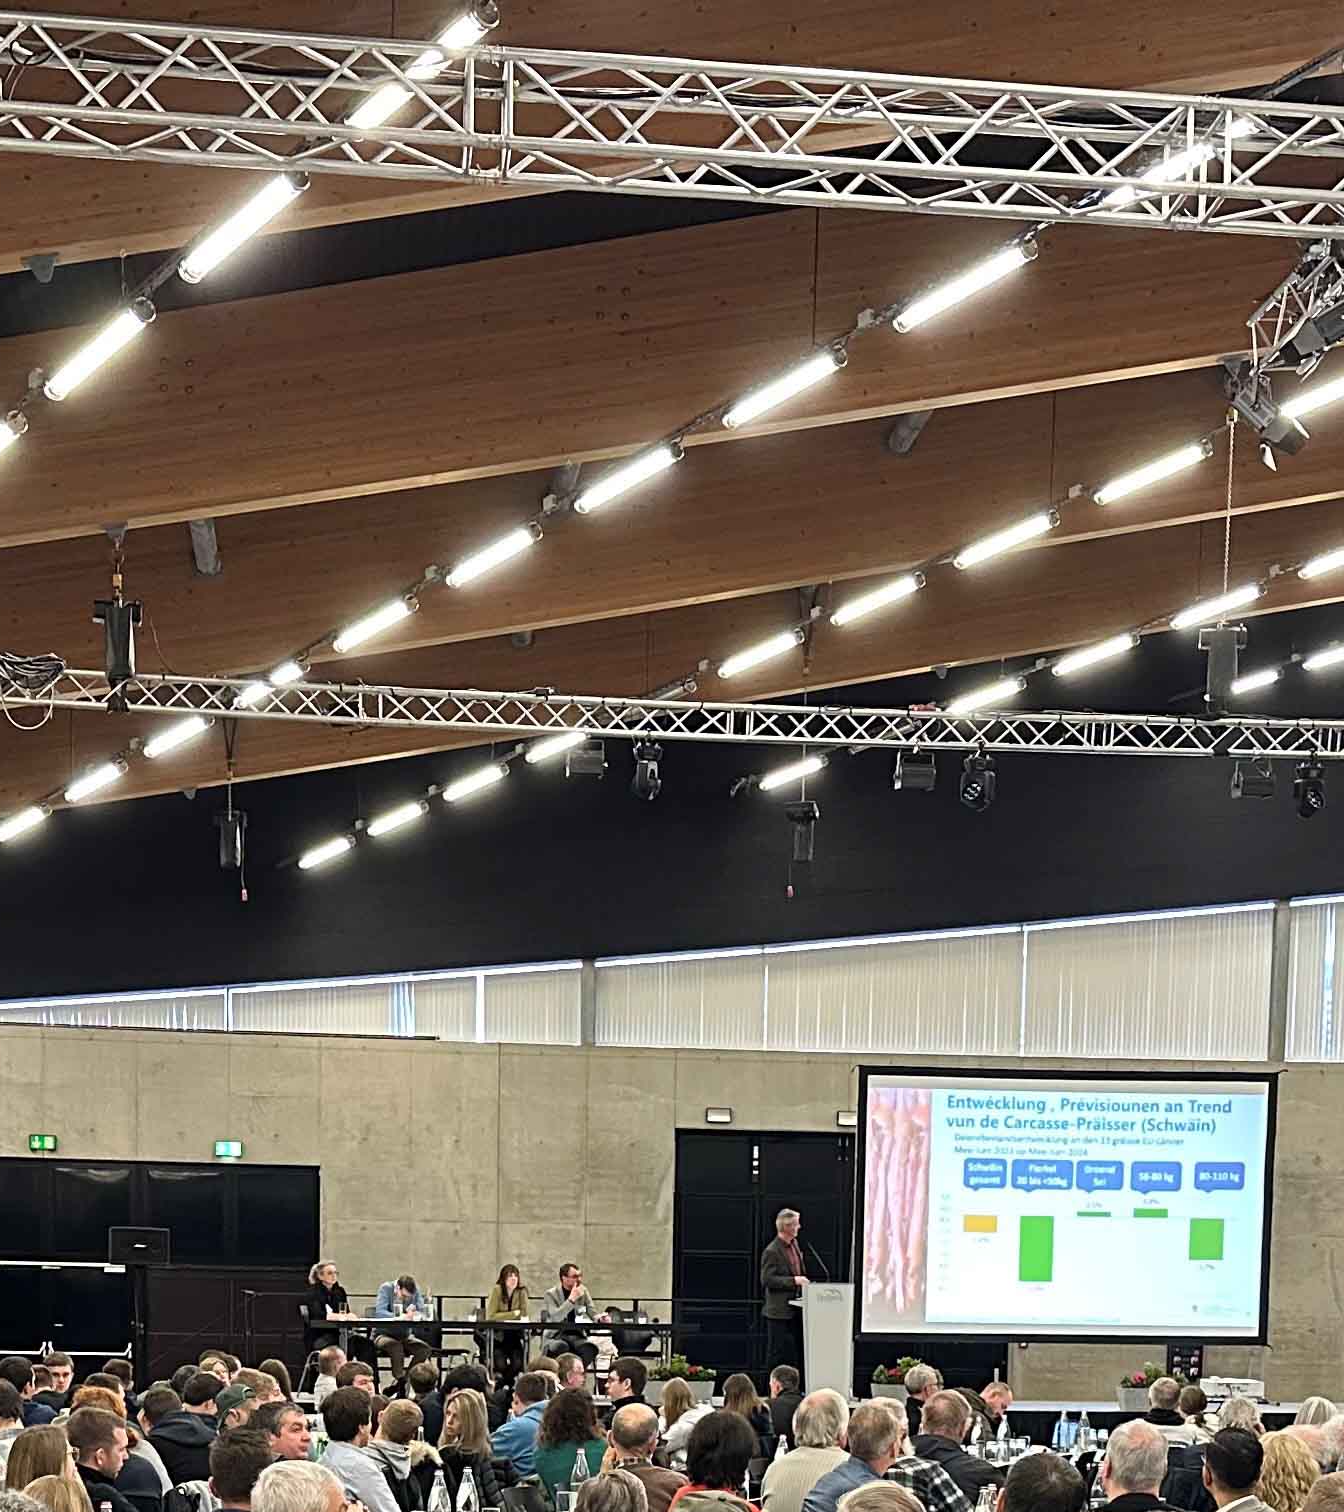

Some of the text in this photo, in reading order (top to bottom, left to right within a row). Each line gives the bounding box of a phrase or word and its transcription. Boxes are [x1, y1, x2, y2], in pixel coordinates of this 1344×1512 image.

[1164, 1102, 1183, 1113] an
[1188, 1099, 1232, 1113] Trend
[946, 1117, 975, 1128] vun
[980, 1114, 999, 1128] de
